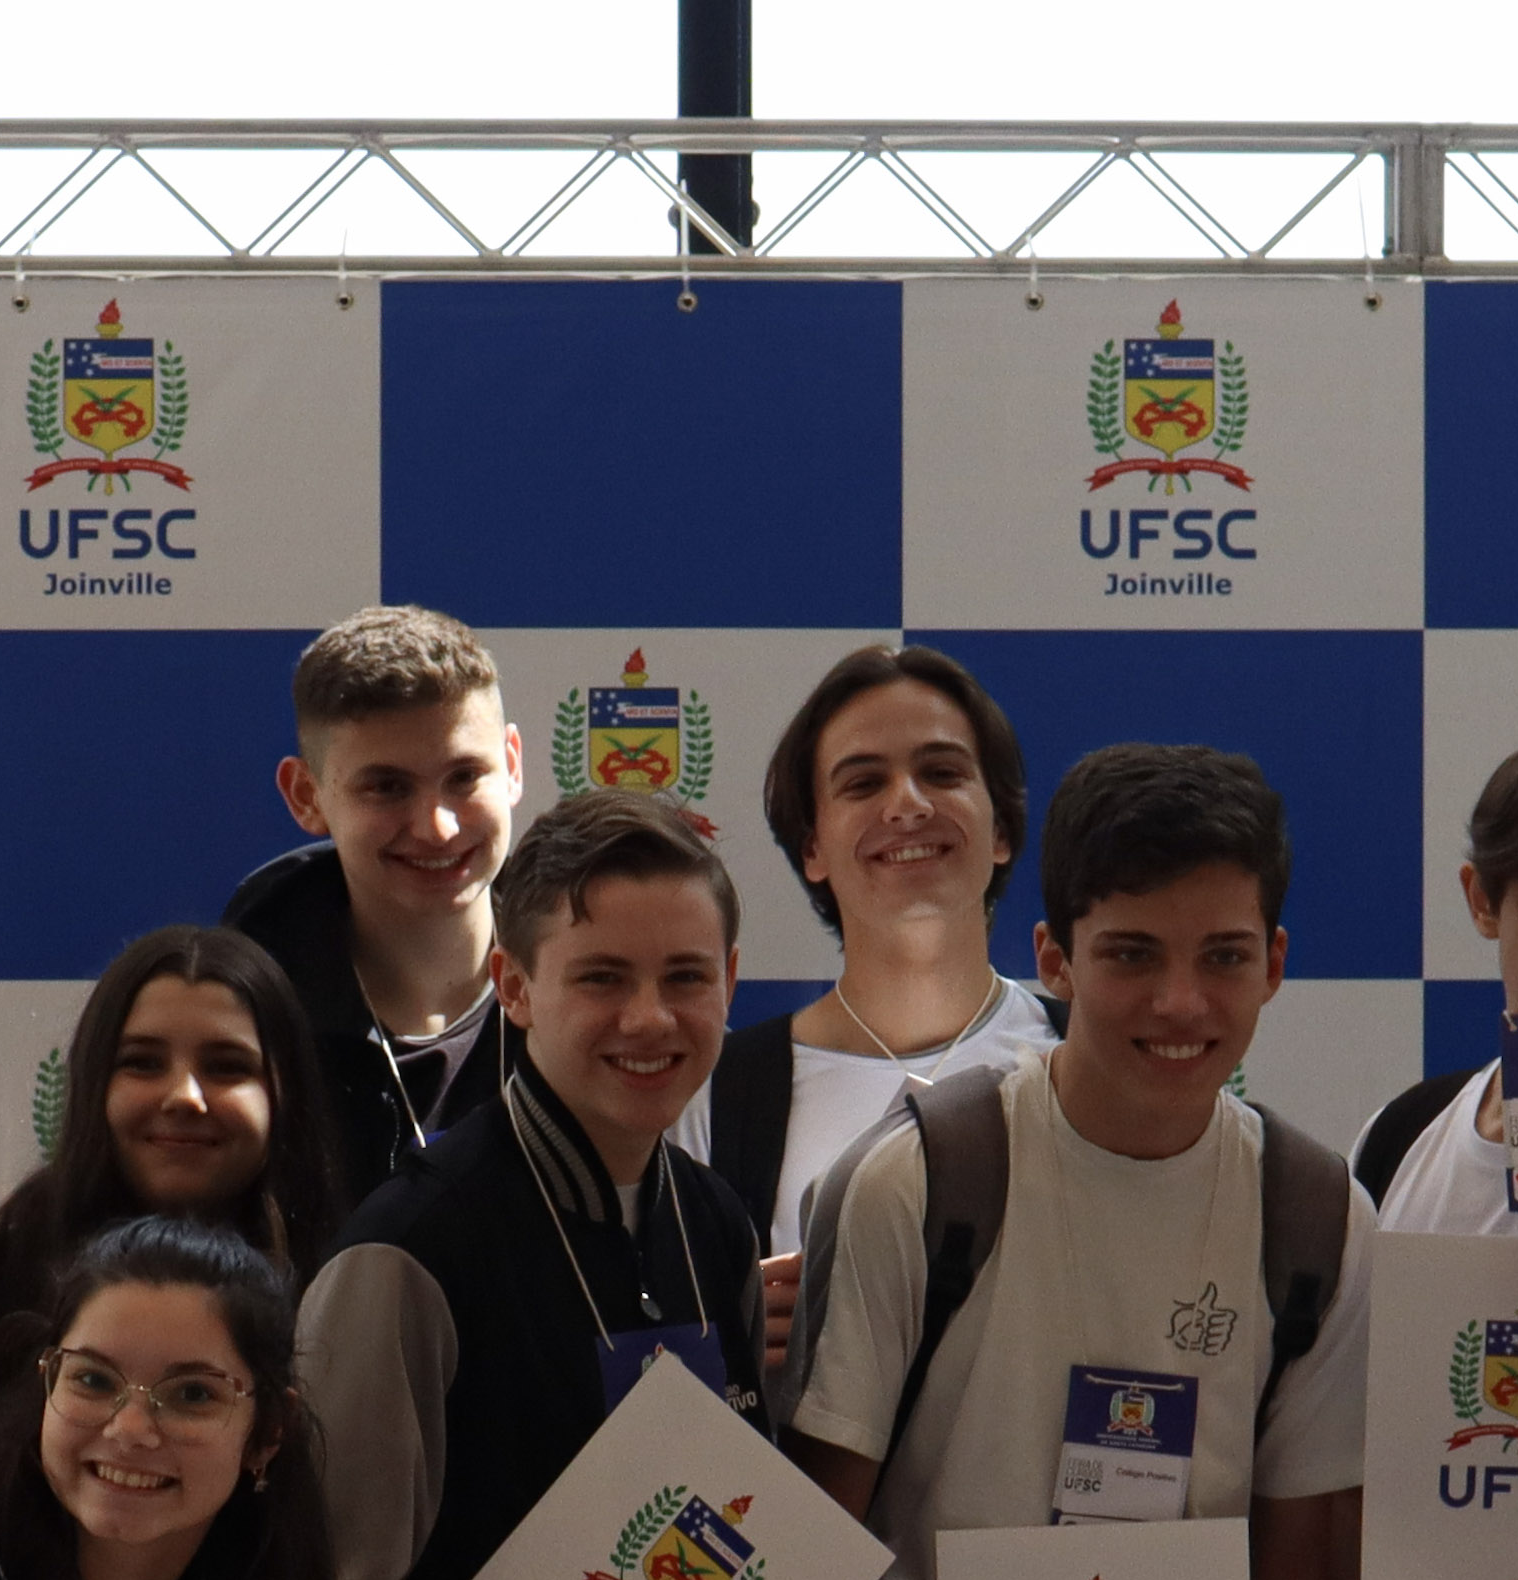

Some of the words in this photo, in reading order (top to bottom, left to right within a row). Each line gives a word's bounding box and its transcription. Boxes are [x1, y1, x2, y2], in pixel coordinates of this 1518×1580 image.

[19, 508, 197, 560] UFSC
[1079, 508, 1257, 560] UFSC
[43, 573, 172, 596] Joinville
[1104, 573, 1233, 596] Joinville
[1064, 1477, 1102, 1492] UFSC
